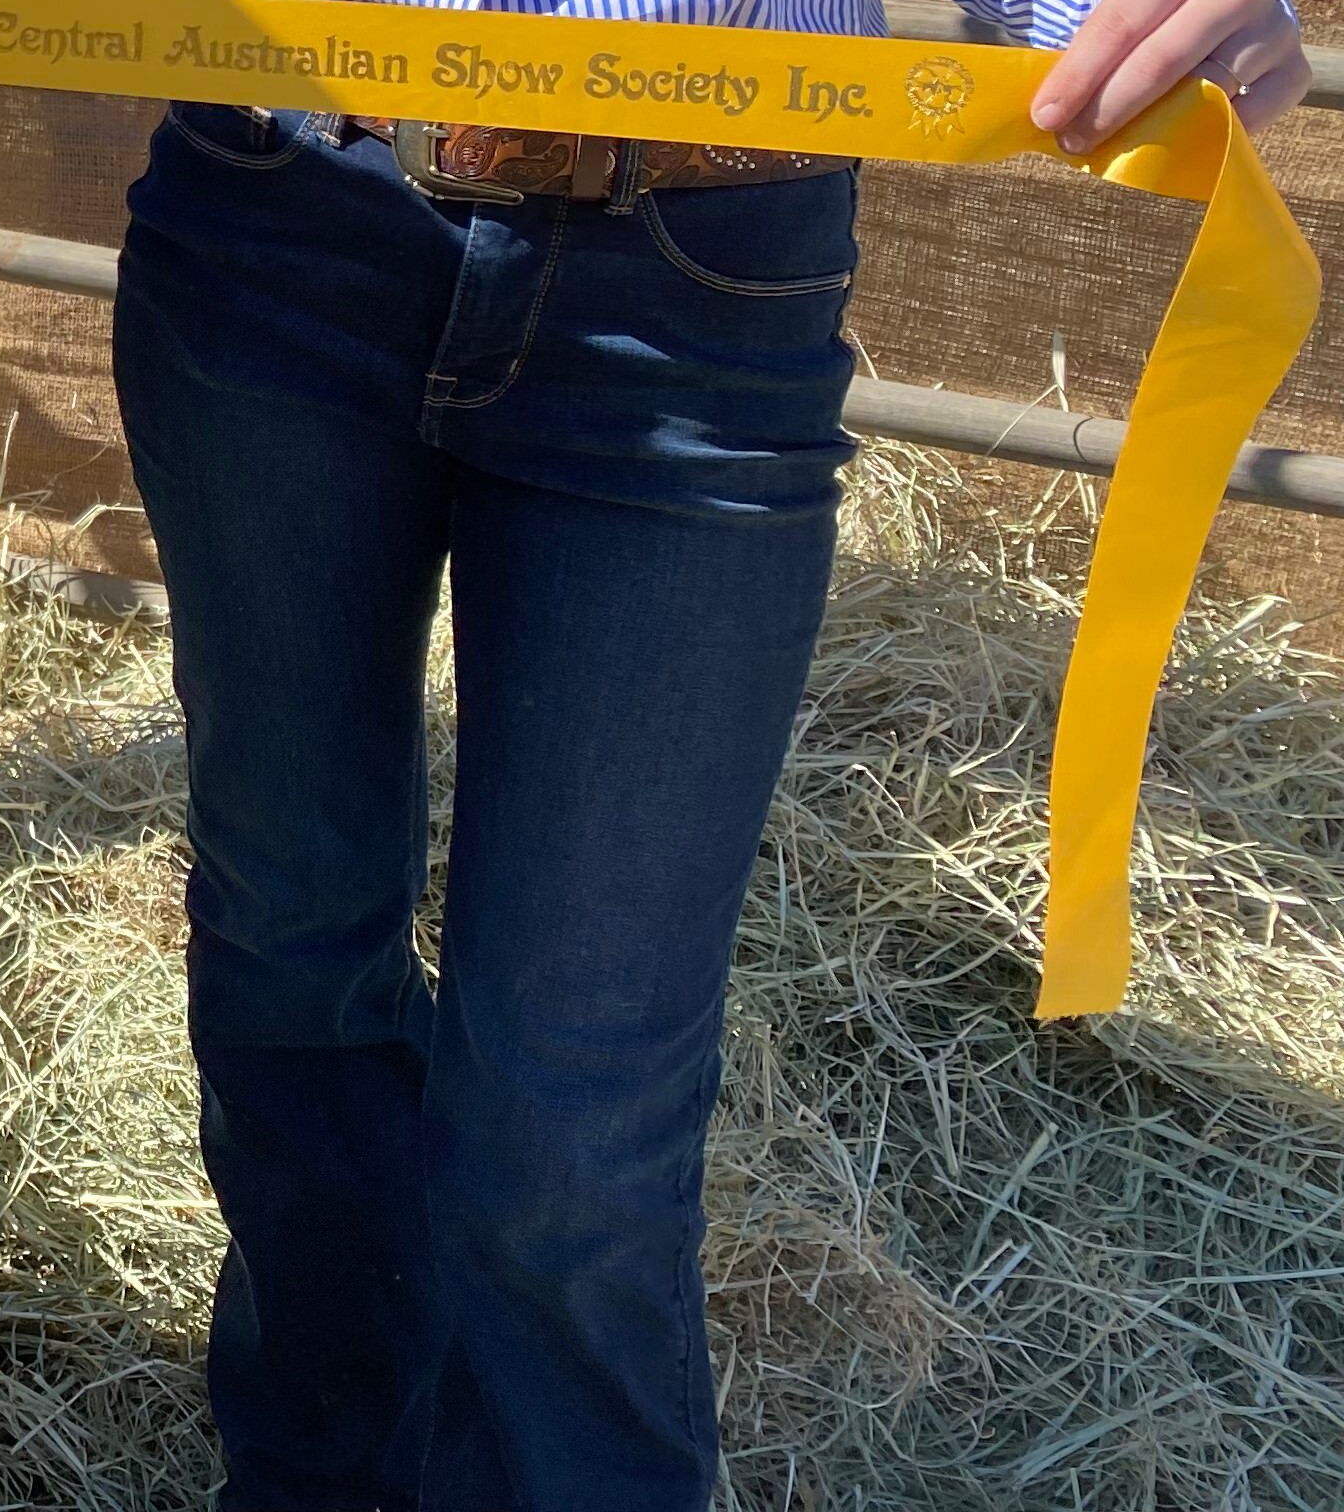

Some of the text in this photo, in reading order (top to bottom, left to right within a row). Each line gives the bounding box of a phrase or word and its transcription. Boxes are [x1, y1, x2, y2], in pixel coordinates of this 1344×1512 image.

[164, 25, 410, 84] Australian
[431, 42, 564, 99] Show
[584, 52, 760, 117] Society
[782, 64, 873, 123] Inc.
